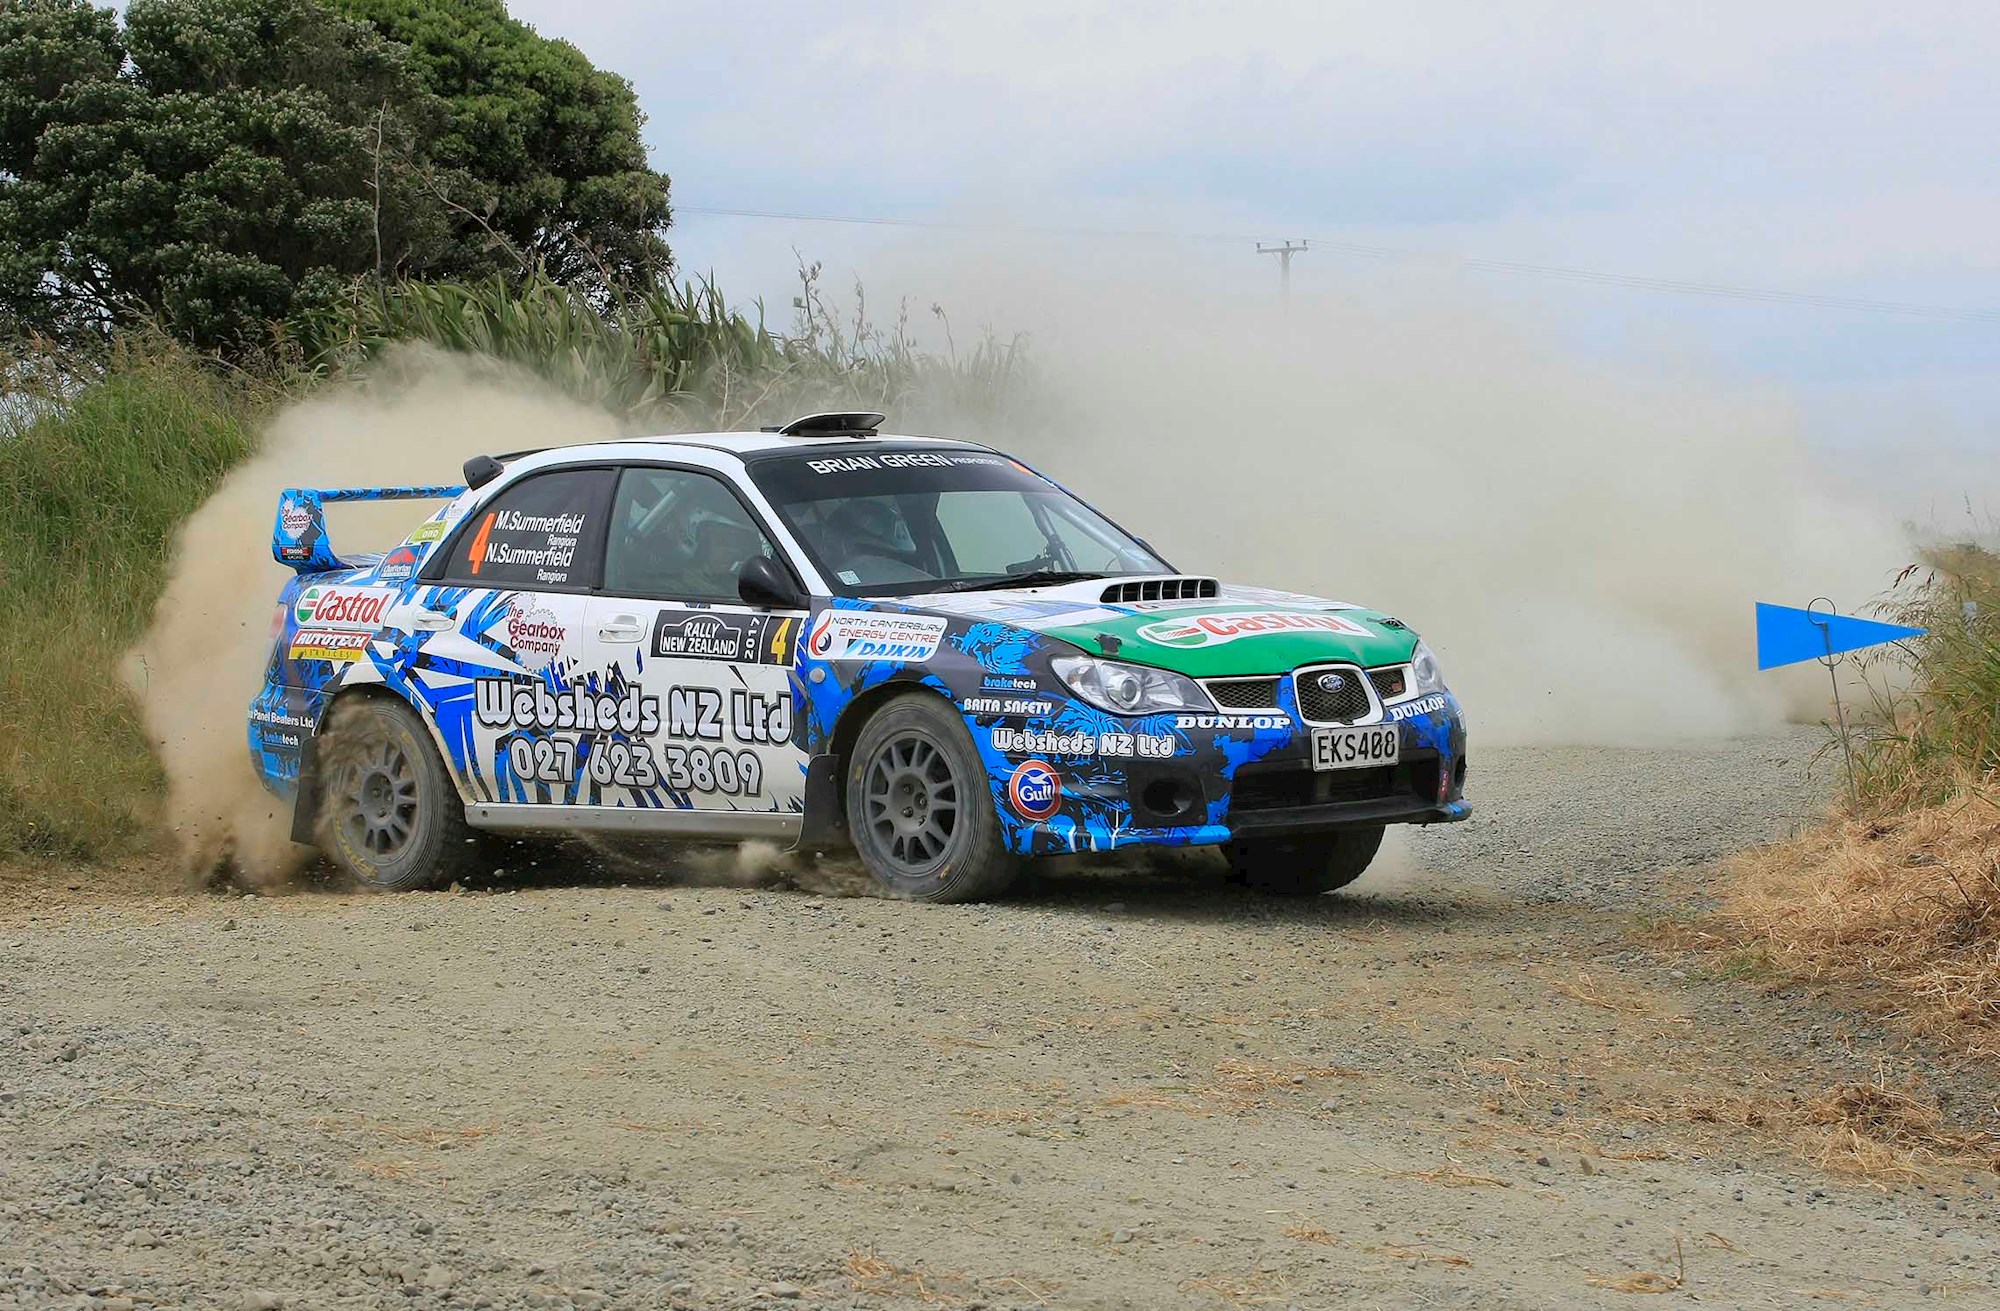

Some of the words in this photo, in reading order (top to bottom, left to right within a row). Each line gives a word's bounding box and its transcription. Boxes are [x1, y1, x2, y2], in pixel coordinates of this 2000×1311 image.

[806, 455, 882, 475] BRIAN
[878, 453, 955, 468] GREEN
[494, 510, 585, 534] M.Summerfield
[468, 512, 496, 574] 4
[547, 533, 577, 548] Rangiora
[484, 542, 575, 567] N.Summerfield
[536, 568, 567, 584] Rangiora
[315, 590, 390, 624] Castrol
[507, 602, 523, 618] The
[508, 618, 566, 640] Gearbox
[684, 621, 720, 639] RALLY
[832, 617, 867, 626] NORTH
[870, 619, 944, 632] CANTERBURY
[1197, 613, 1363, 635] Castrol
[296, 633, 366, 649] AUTOTECH
[745, 617, 761, 660] 2017
[771, 618, 792, 664] 4
[839, 628, 887, 640] ENERGY
[889, 631, 938, 643] CENTRE
[510, 636, 560, 656] Company
[662, 637, 687, 652] NEW
[688, 637, 736, 655] ZEALAND
[858, 642, 932, 658] DAIKIN
[984, 676, 1036, 689] braketech
[475, 677, 660, 737] Websheds
[669, 685, 722, 740] NZ
[730, 688, 793, 743] Ltd
[963, 698, 1000, 712] BRITA
[1003, 700, 1052, 714] SAFETY
[1390, 696, 1446, 721] DUNLOP
[253, 709, 270, 722] Panel
[271, 712, 299, 726] Beaters
[300, 717, 314, 728] Ltd
[1175, 716, 1292, 730] DUNLOP
[992, 728, 1095, 754] Websheds
[1099, 732, 1134, 756] NZ
[1137, 735, 1175, 758] Ltd
[1318, 731, 1395, 763] EKS408
[510, 736, 577, 783] 027
[590, 742, 656, 789] 623
[667, 743, 762, 797] 3809
[1019, 783, 1054, 803] Gull
